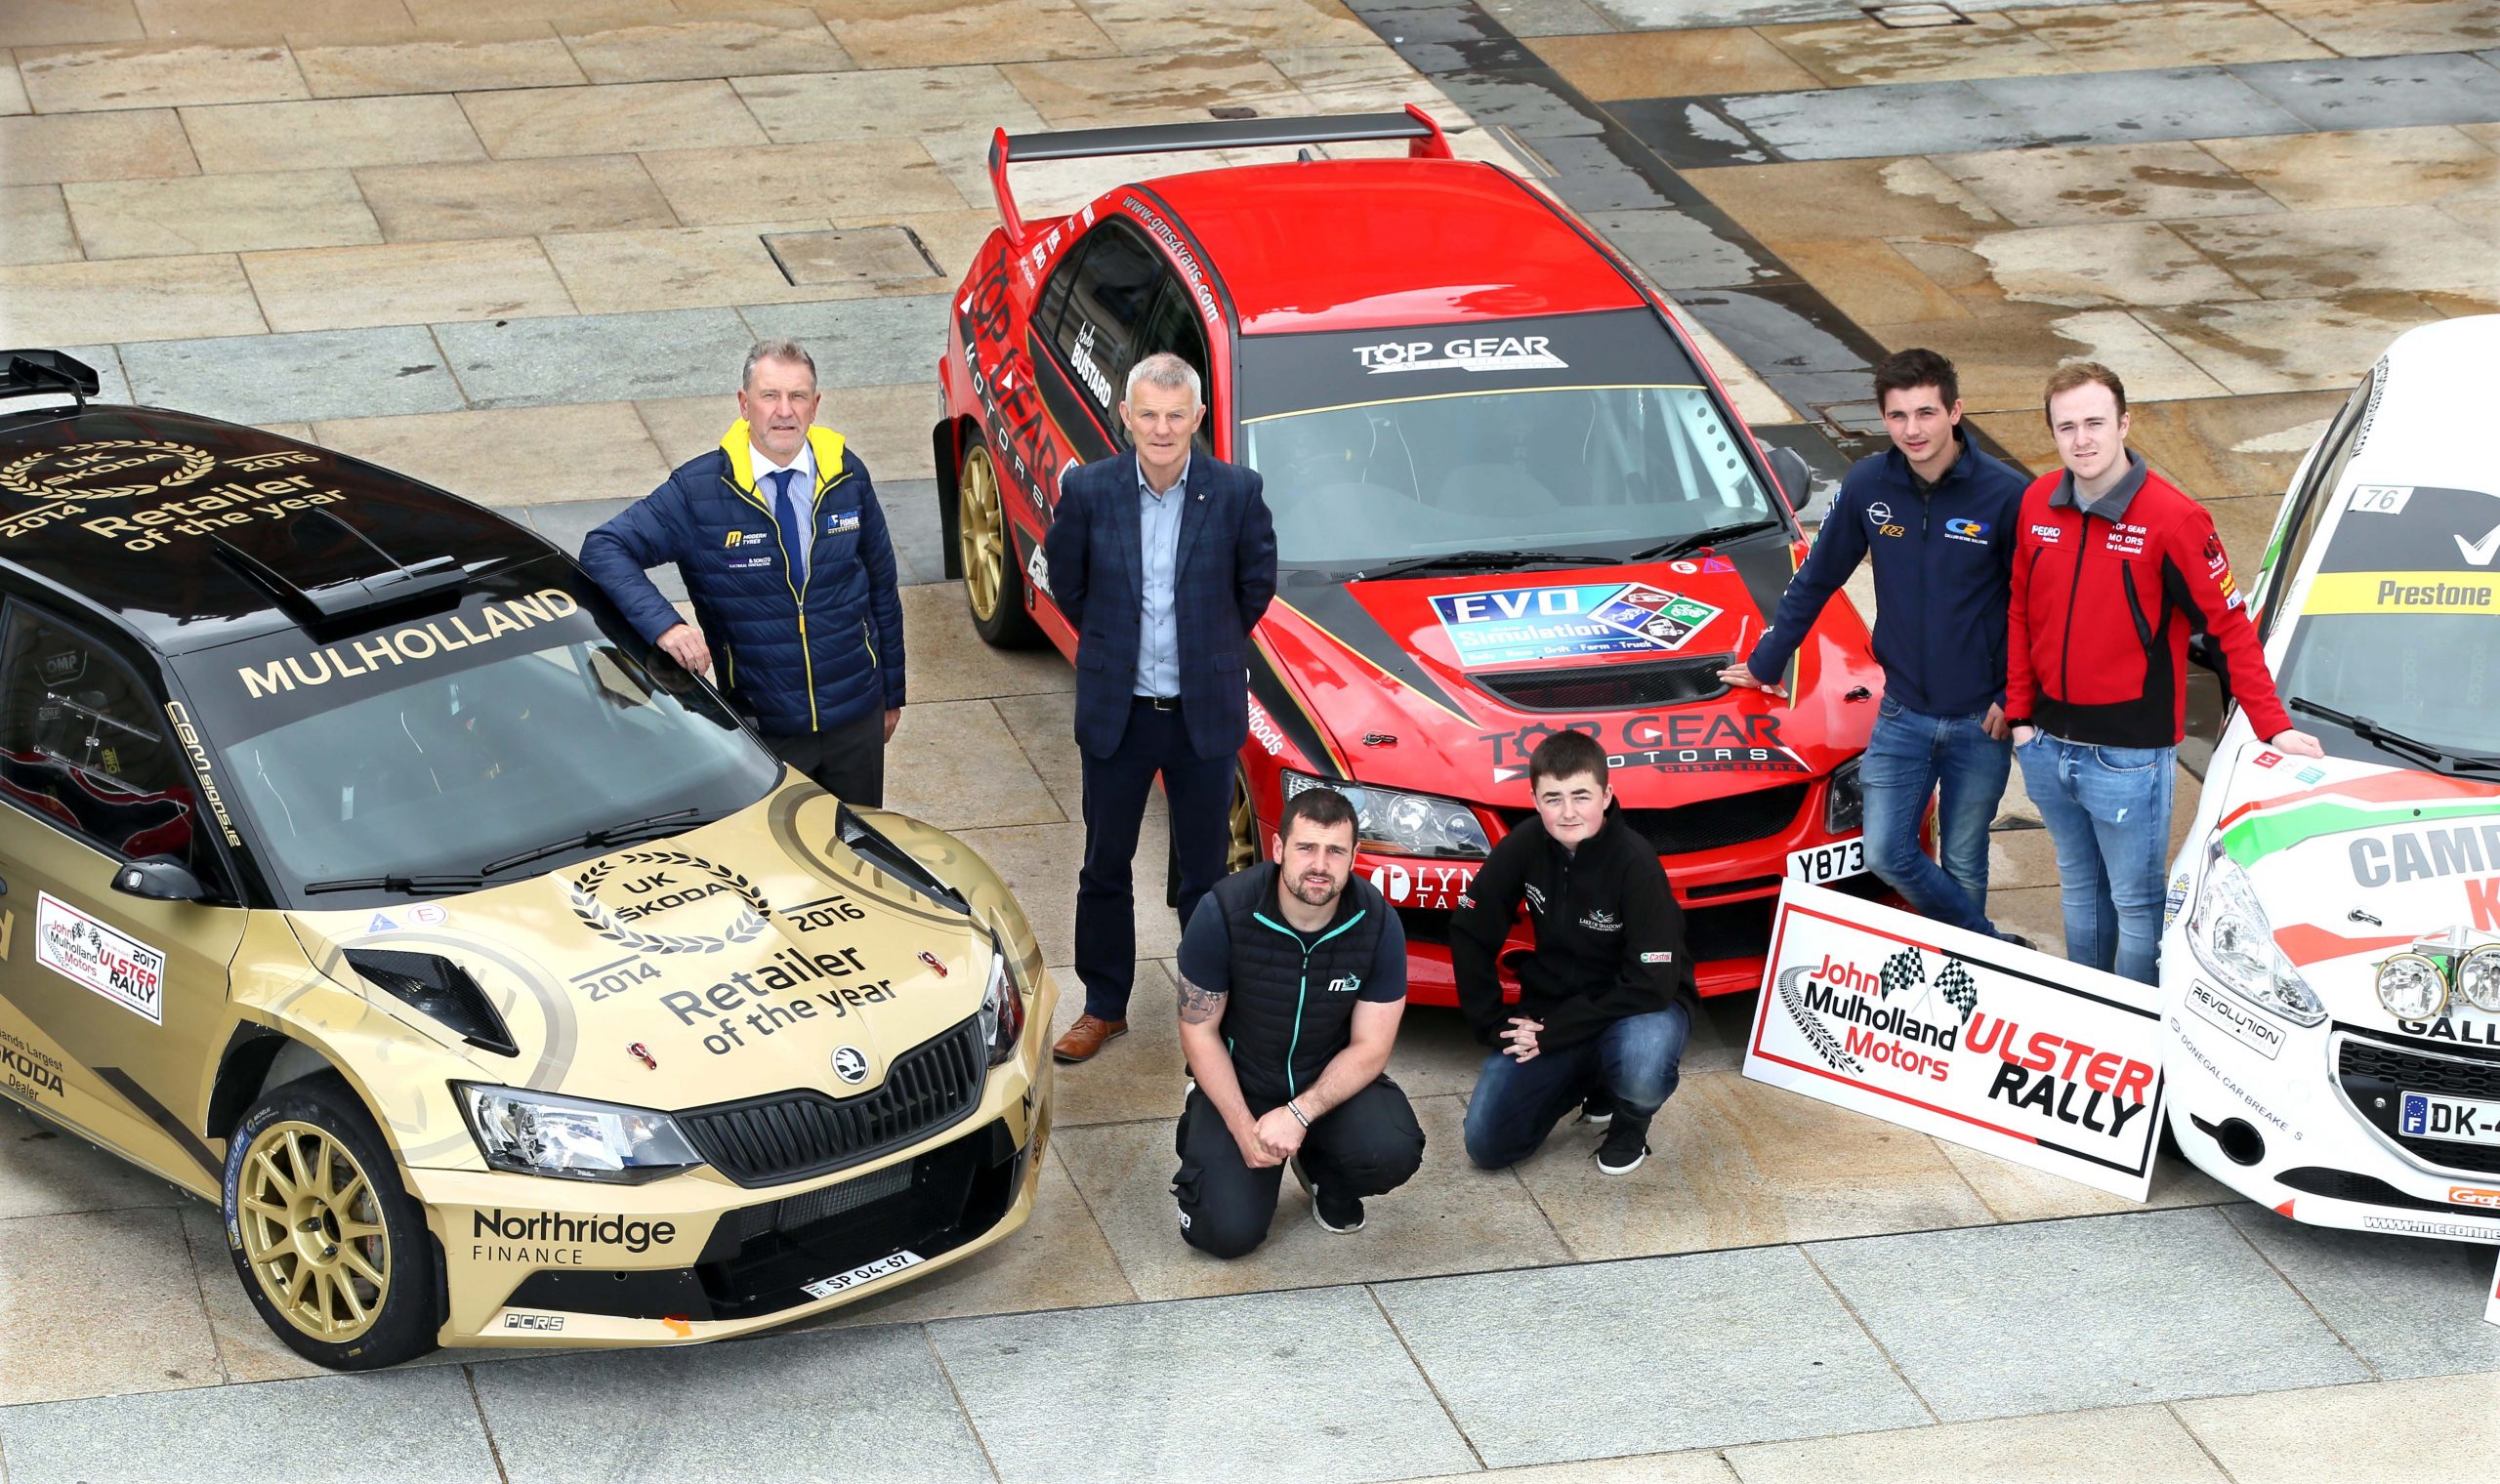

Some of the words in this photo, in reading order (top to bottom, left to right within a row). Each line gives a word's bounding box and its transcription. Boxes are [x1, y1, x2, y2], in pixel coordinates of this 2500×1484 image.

[1123, 195, 1221, 324] www.gms4vans.com
[976, 247, 1012, 344] TOP
[1353, 342, 1434, 366] TOP
[1443, 336, 1557, 358] GEAR
[1070, 342, 1112, 408] BUSTARD
[965, 343, 1044, 508] MOTORS
[56, 452, 116, 469] UK
[234, 453, 320, 473] 2016
[81, 475, 314, 538] Retailer
[2363, 489, 2398, 510] 76
[0, 503, 86, 538] 2014
[125, 528, 171, 552] of
[173, 511, 253, 536] the
[253, 489, 347, 518] year
[2031, 525, 2061, 537] PEDRO
[2127, 525, 2146, 534] GEAR
[1453, 589, 1579, 623] EVO
[2377, 580, 2492, 606] Prestone
[238, 589, 579, 699] MULHOLLAND
[1456, 621, 1610, 648] Simulation
[1544, 644, 1571, 654] Drift
[1580, 641, 1610, 652] Farm
[1619, 639, 1653, 649] Truck
[46, 655, 78, 674] OMP
[168, 701, 212, 771] CBM
[1622, 714, 1787, 749] GEAR
[104, 748, 119, 773] OMP
[1606, 748, 1770, 768] OTORS
[1798, 842, 1865, 883] Y873
[623, 872, 678, 894] UK
[51, 921, 72, 937] John
[787, 902, 866, 932] 2016
[50, 930, 98, 964] Mulholland
[64, 951, 97, 976] Motors
[133, 950, 157, 969] 2017
[100, 949, 157, 991] ULSTER
[109, 969, 156, 1004] RALLY
[579, 962, 662, 1002] 2014
[659, 946, 866, 1026] Retailer
[1811, 954, 1879, 996] John
[703, 1018, 744, 1055] of
[746, 999, 818, 1036] the
[817, 979, 897, 1018] year
[1803, 982, 1959, 1051] Mulholland
[2192, 986, 2279, 1045] REVOLUTION
[0, 1031, 24, 1051] ands
[26, 1042, 63, 1072] Largest
[1845, 1026, 1949, 1082] Motors
[1965, 1011, 2153, 1104] ULSTER
[2181, 1034, 2222, 1079] DONEGAL
[2223, 1077, 2244, 1098] CAR
[8, 1073, 40, 1101] Dealer
[1987, 1061, 2146, 1137] RALLY
[2408, 1117, 2422, 1131] F
[226, 1130, 245, 1215] MICHELIN
[474, 1209, 676, 1253] Northridge
[473, 1246, 583, 1264] FINANCE
[826, 1275, 852, 1290] SP
[854, 1255, 910, 1279] 04-67
[504, 1314, 564, 1331] PCRS
